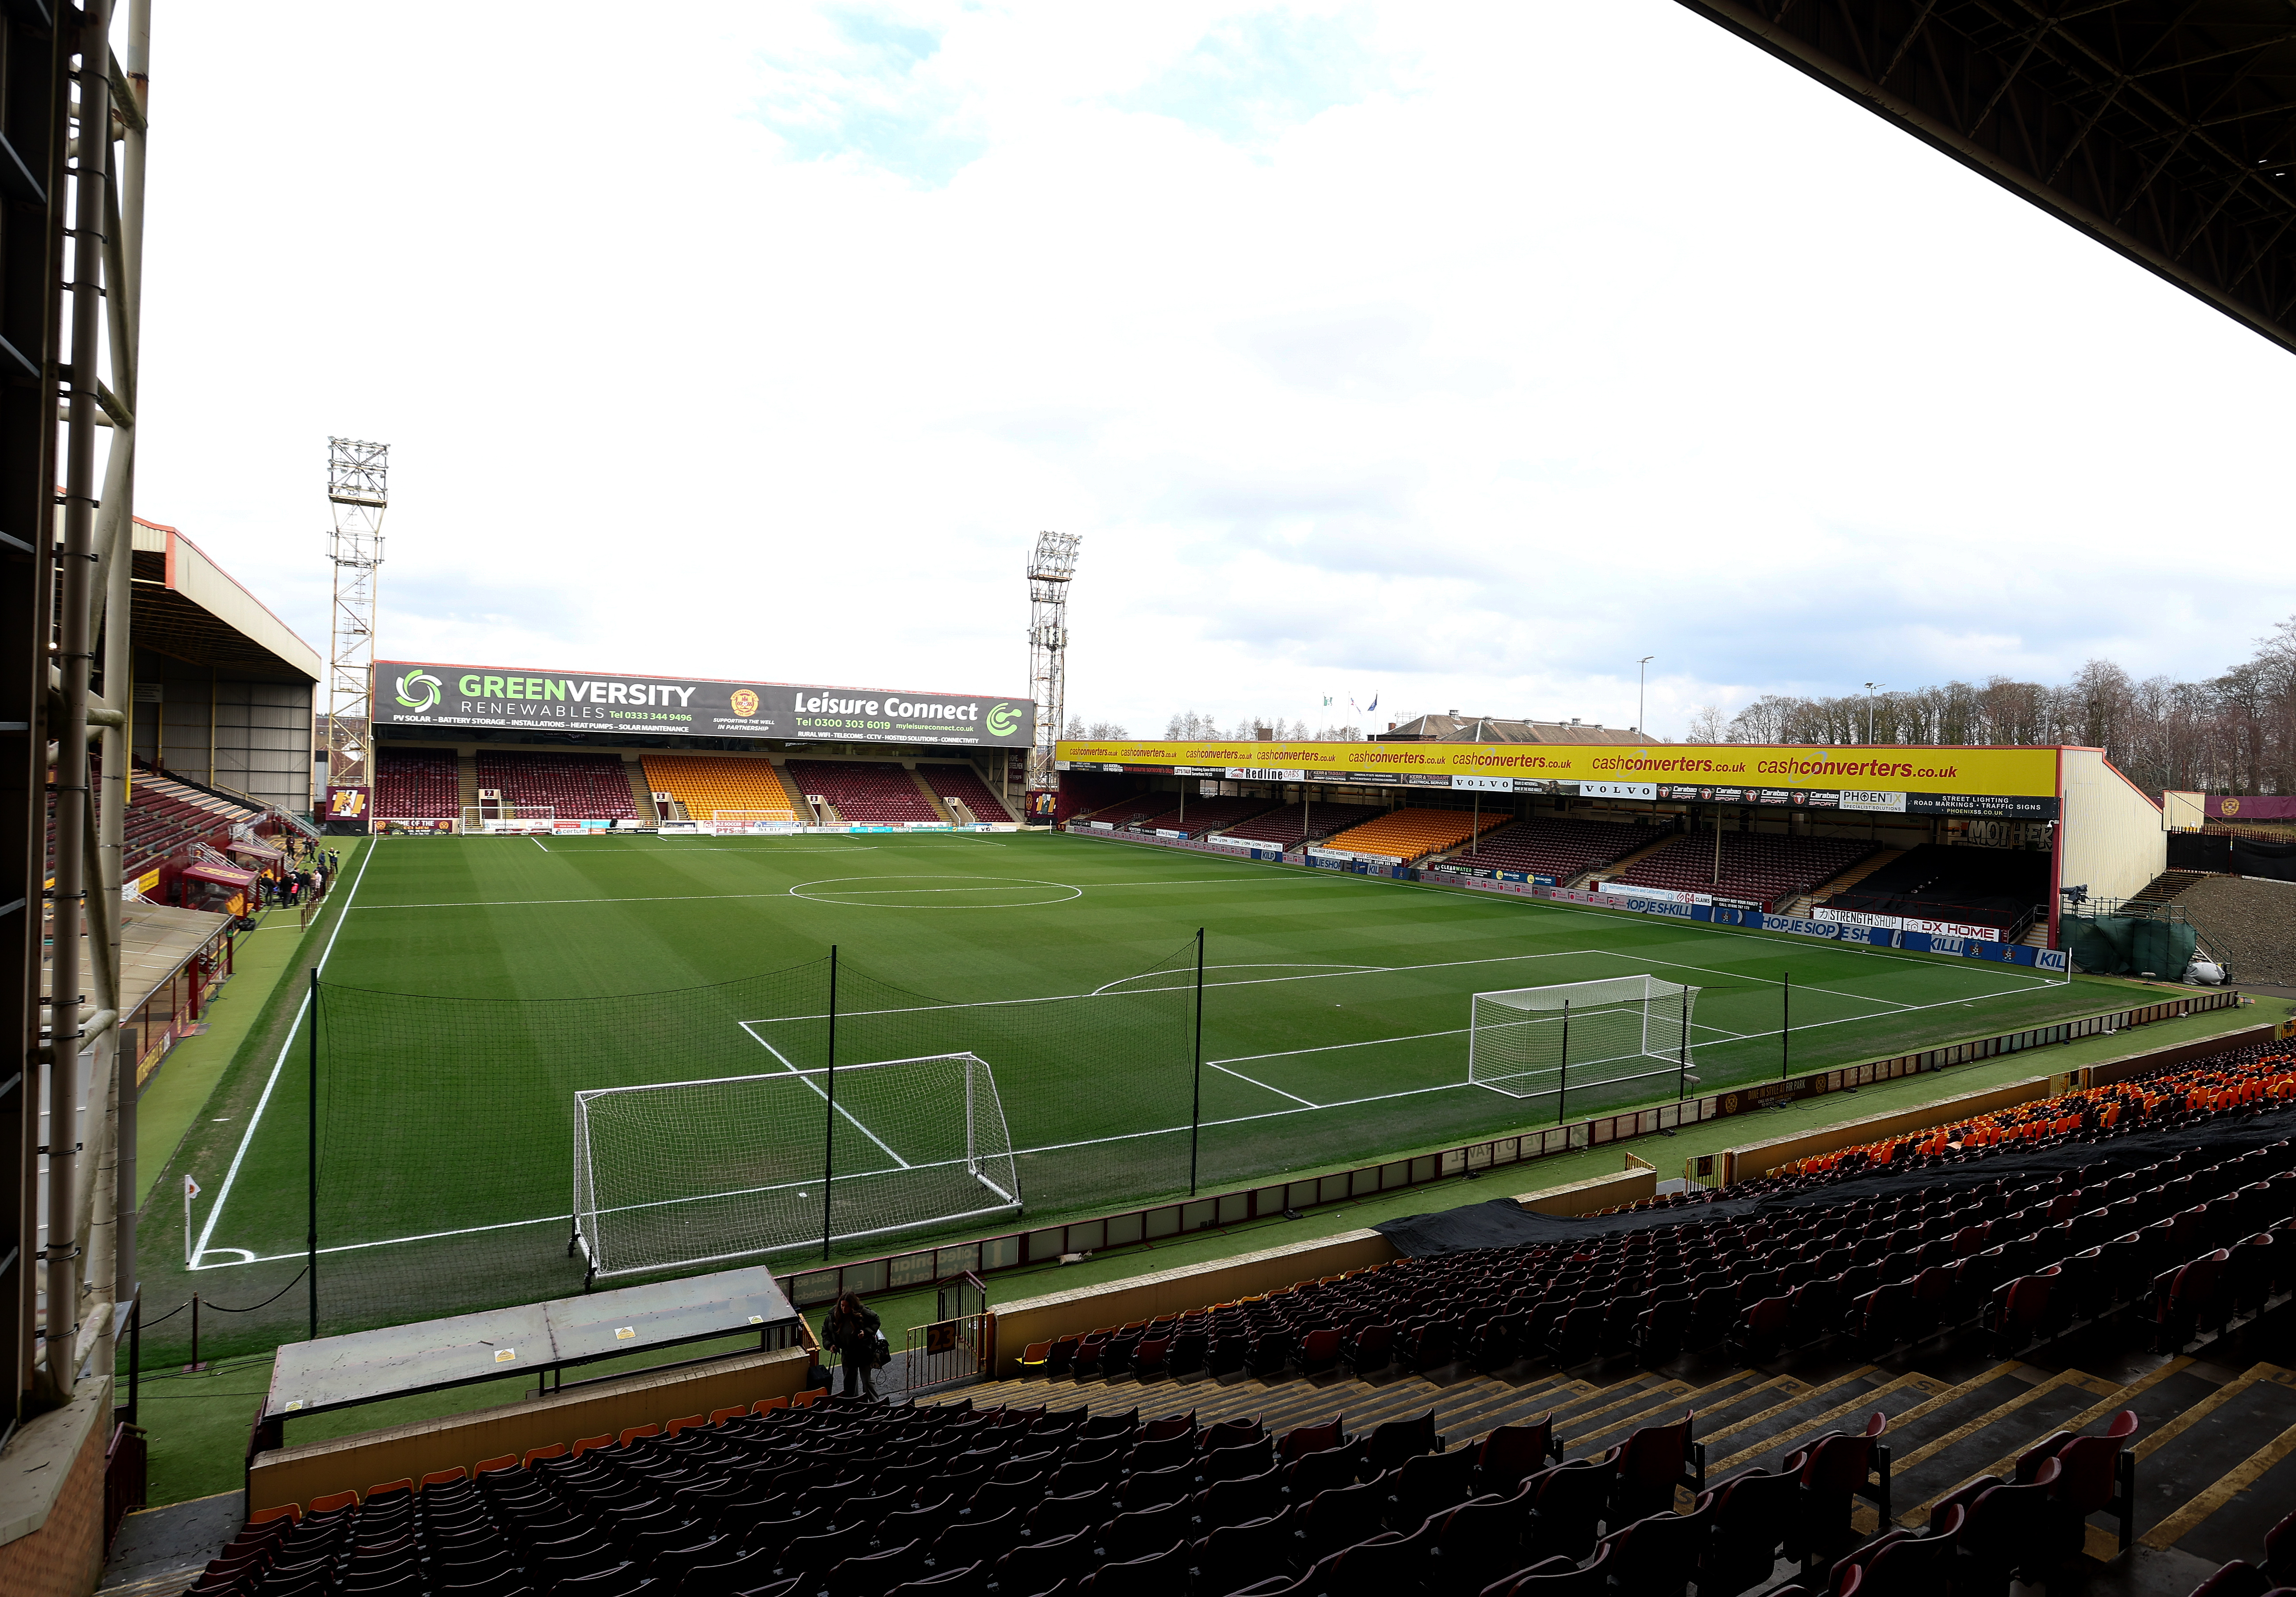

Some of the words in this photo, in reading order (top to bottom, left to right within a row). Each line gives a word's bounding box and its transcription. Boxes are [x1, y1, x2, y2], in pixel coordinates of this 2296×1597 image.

[459, 674, 696, 707] GREENVERSITY
[461, 701, 604, 718] RENEWABLES
[794, 691, 878, 715] Leisure
[884, 697, 978, 720] Connect
[796, 717, 812, 726] Tel
[814, 719, 842, 728] 0300
[867, 721, 890, 729] 6019
[896, 723, 973, 732] myleisureconnect.co.uk
[1070, 747, 1117, 756] cashconverters.co.uk
[1121, 747, 1177, 758] cashconverters.co.uk
[1186, 748, 1253, 760] cashconverters.co.uk
[1257, 749, 1336, 762] cashconverters.co.uk
[1349, 751, 1446, 765] cashconverters.co.uk
[1453, 752, 1571, 768] cashconverters.co.uk
[1592, 755, 1746, 772] cashconverters.co.uk
[1758, 757, 1958, 778] cashconverters.co.uk
[1246, 768, 1282, 779] Redline
[1456, 779, 1508, 788] VOLVO
[1585, 785, 1650, 795] VOLVO
[1843, 791, 1902, 804] PHOENIX
[1685, 893, 1695, 903] G4
[1830, 910, 1873, 925] STRENGTH
[1874, 915, 1896, 928] SHOP
[1922, 922, 1943, 933] DX
[1947, 926, 1995, 940] HOME
[1748, 1089, 1759, 1100] DINE
[1760, 1088, 1765, 1098] IN
[1766, 1085, 1779, 1096] STYLE
[1779, 1083, 1785, 1093] AT
[1794, 1079, 1805, 1090] PARK
[1699, 1159, 1712, 1174] 22
[928, 1326, 955, 1352] 23
